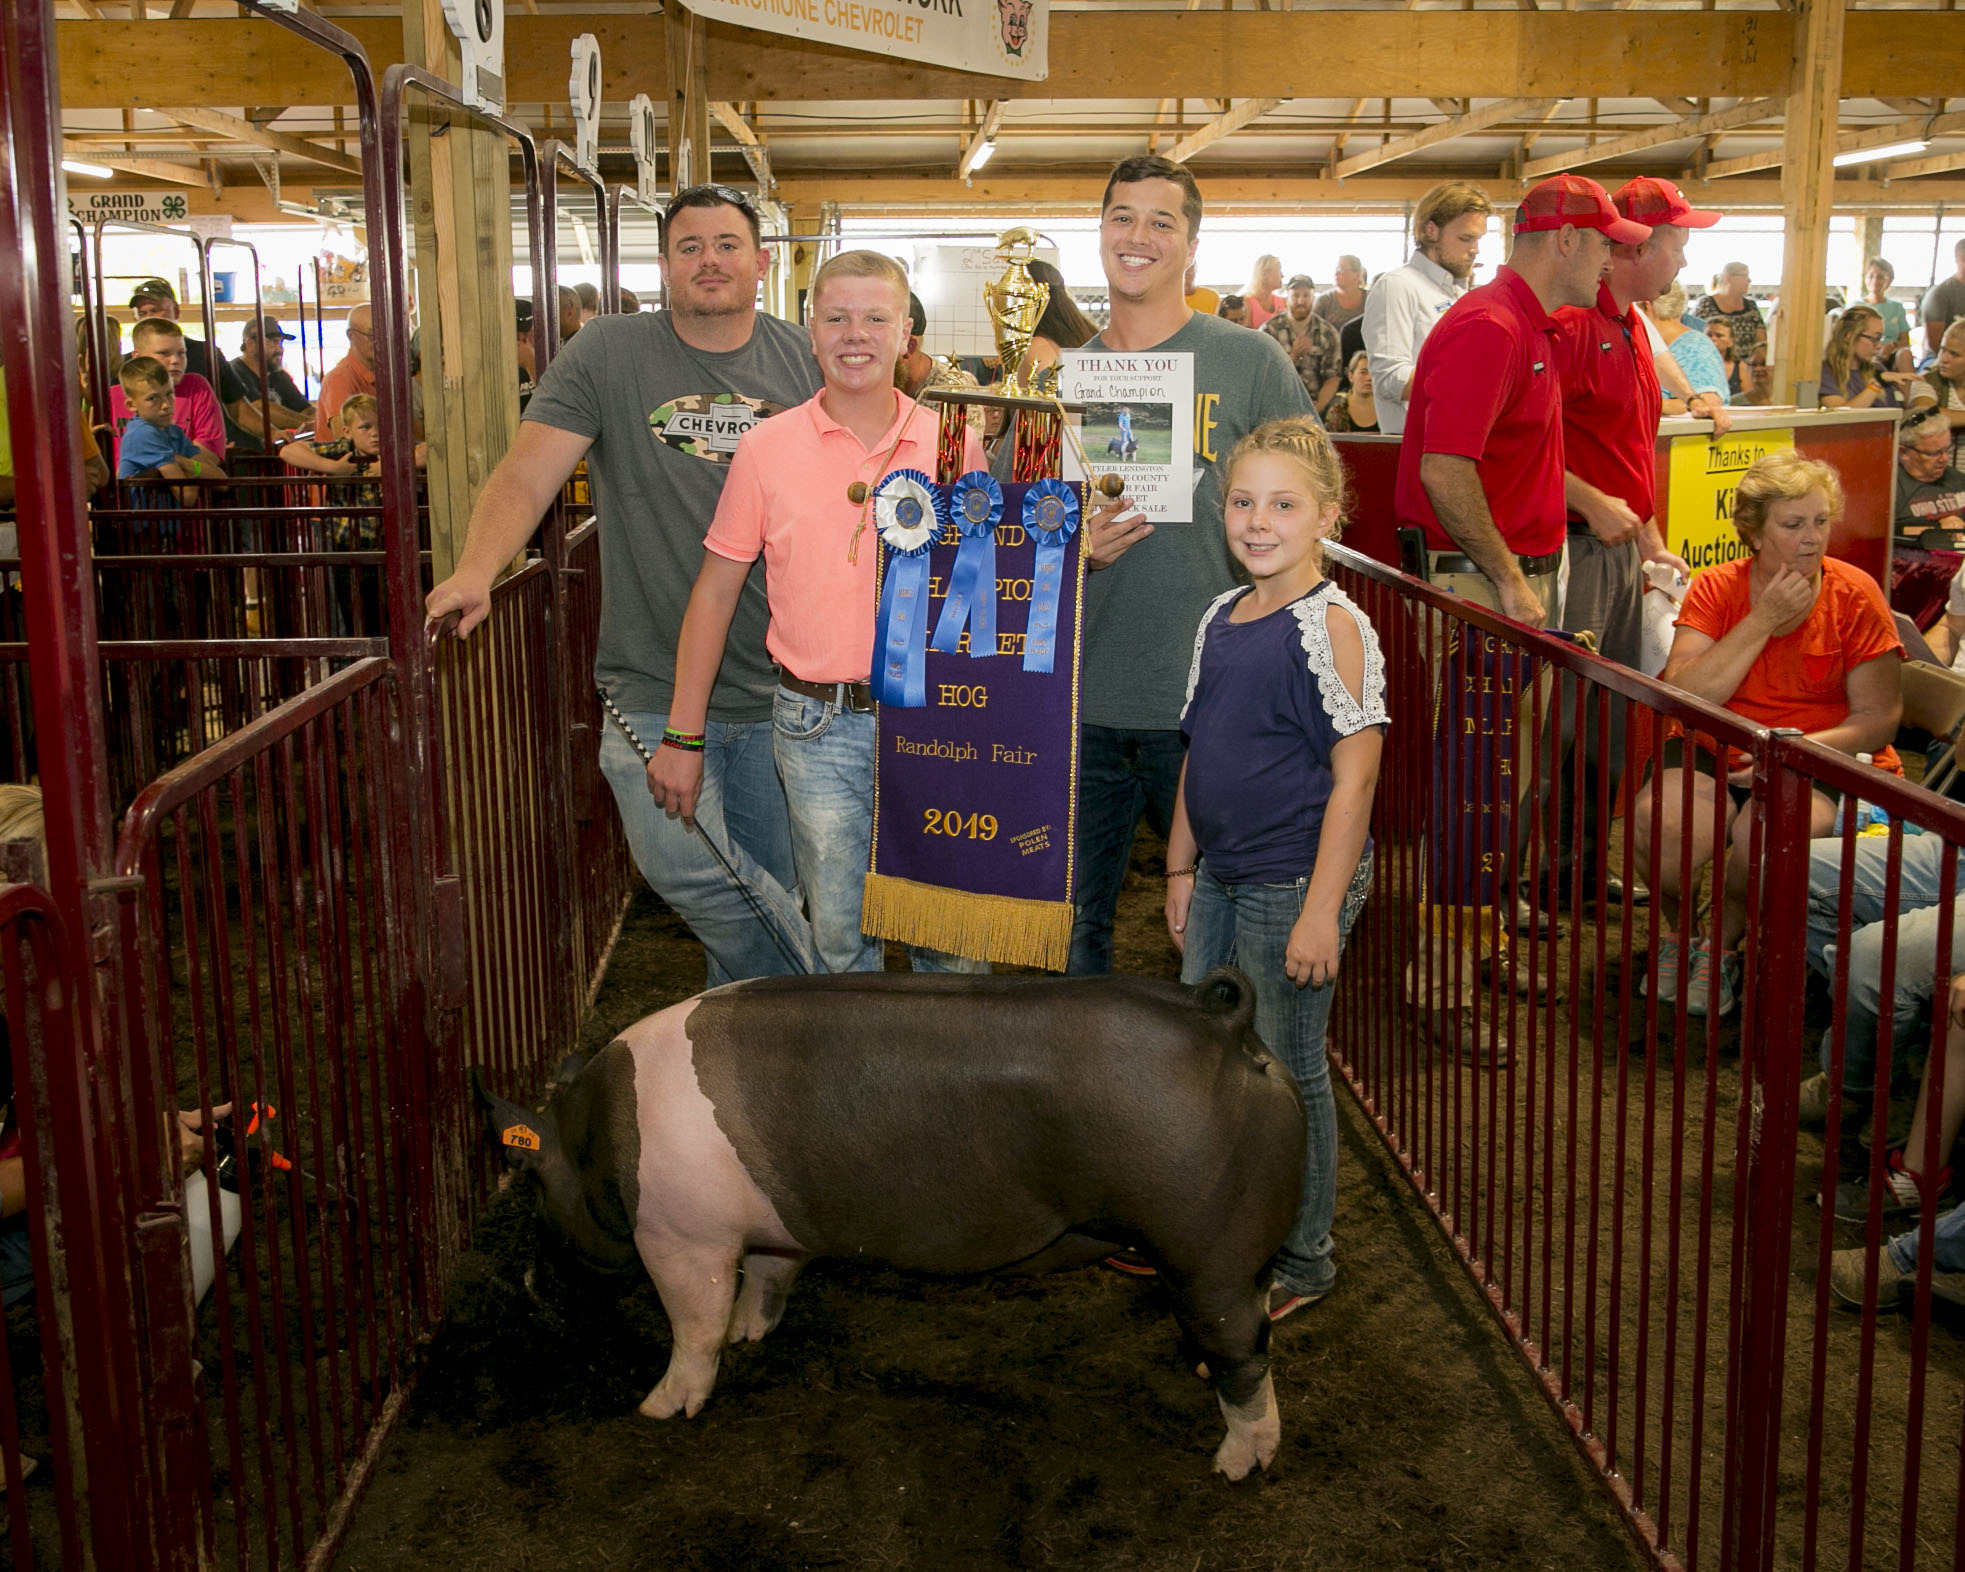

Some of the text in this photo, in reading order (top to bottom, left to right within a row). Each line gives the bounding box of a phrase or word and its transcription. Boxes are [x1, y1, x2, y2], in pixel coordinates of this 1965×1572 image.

[824, 0, 923, 43] CHEVROLET
[90, 194, 145, 208] GRAND
[76, 209, 161, 222] CHAMPION
[1077, 359, 1178, 372] THANK YOU
[1074, 382, 1166, 400] Grand Champion
[679, 417, 758, 435] CHEVRO
[1708, 444, 1750, 469] Thanks
[937, 684, 988, 708] HOG
[896, 735, 1038, 765] Randolph Fair
[922, 808, 998, 841] 2019
[1018, 833, 1048, 848] POLEN
[1021, 841, 1051, 856] MEATS
[510, 1134, 532, 1147] 780
